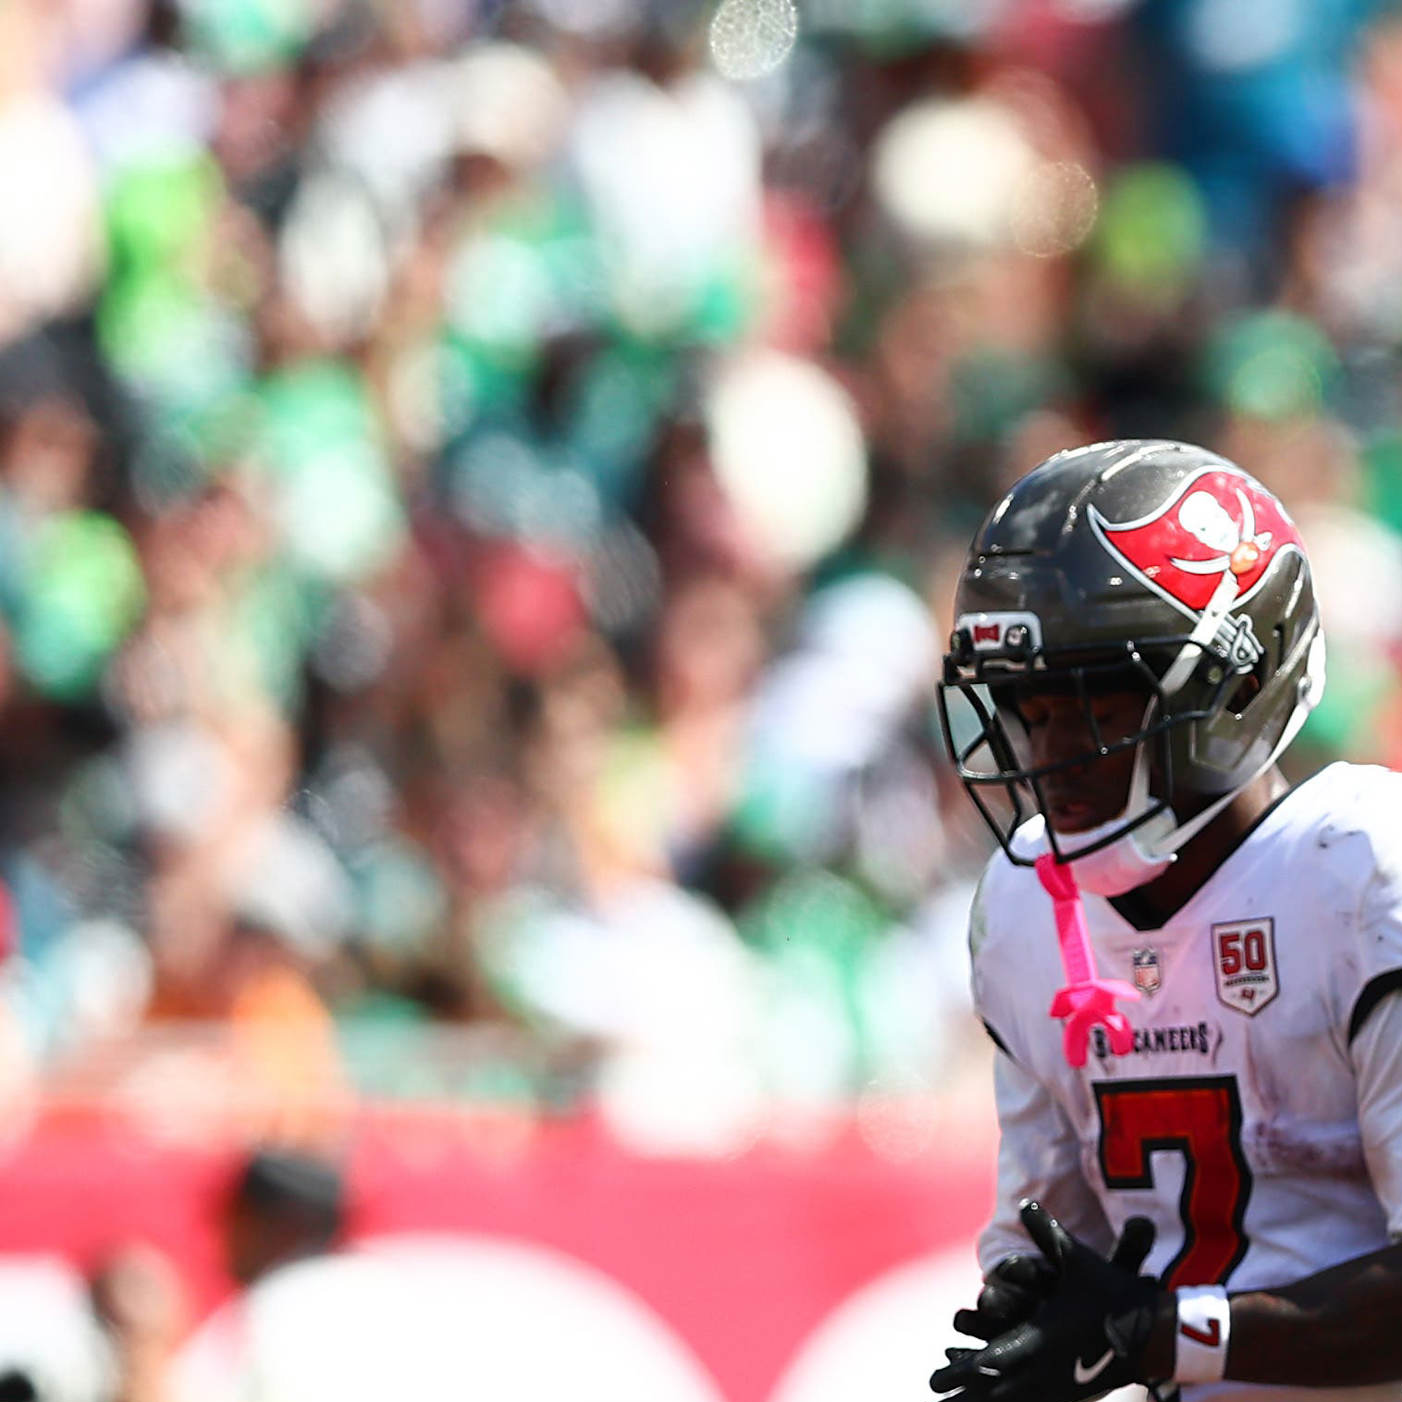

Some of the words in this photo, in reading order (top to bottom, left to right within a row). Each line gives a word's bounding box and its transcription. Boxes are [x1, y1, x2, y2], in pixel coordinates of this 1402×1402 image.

[1219, 929, 1268, 976] 50
[1092, 1021, 1209, 1058] BCANEERS
[1092, 1074, 1253, 1291] 7
[1180, 1317, 1221, 1348] 7
